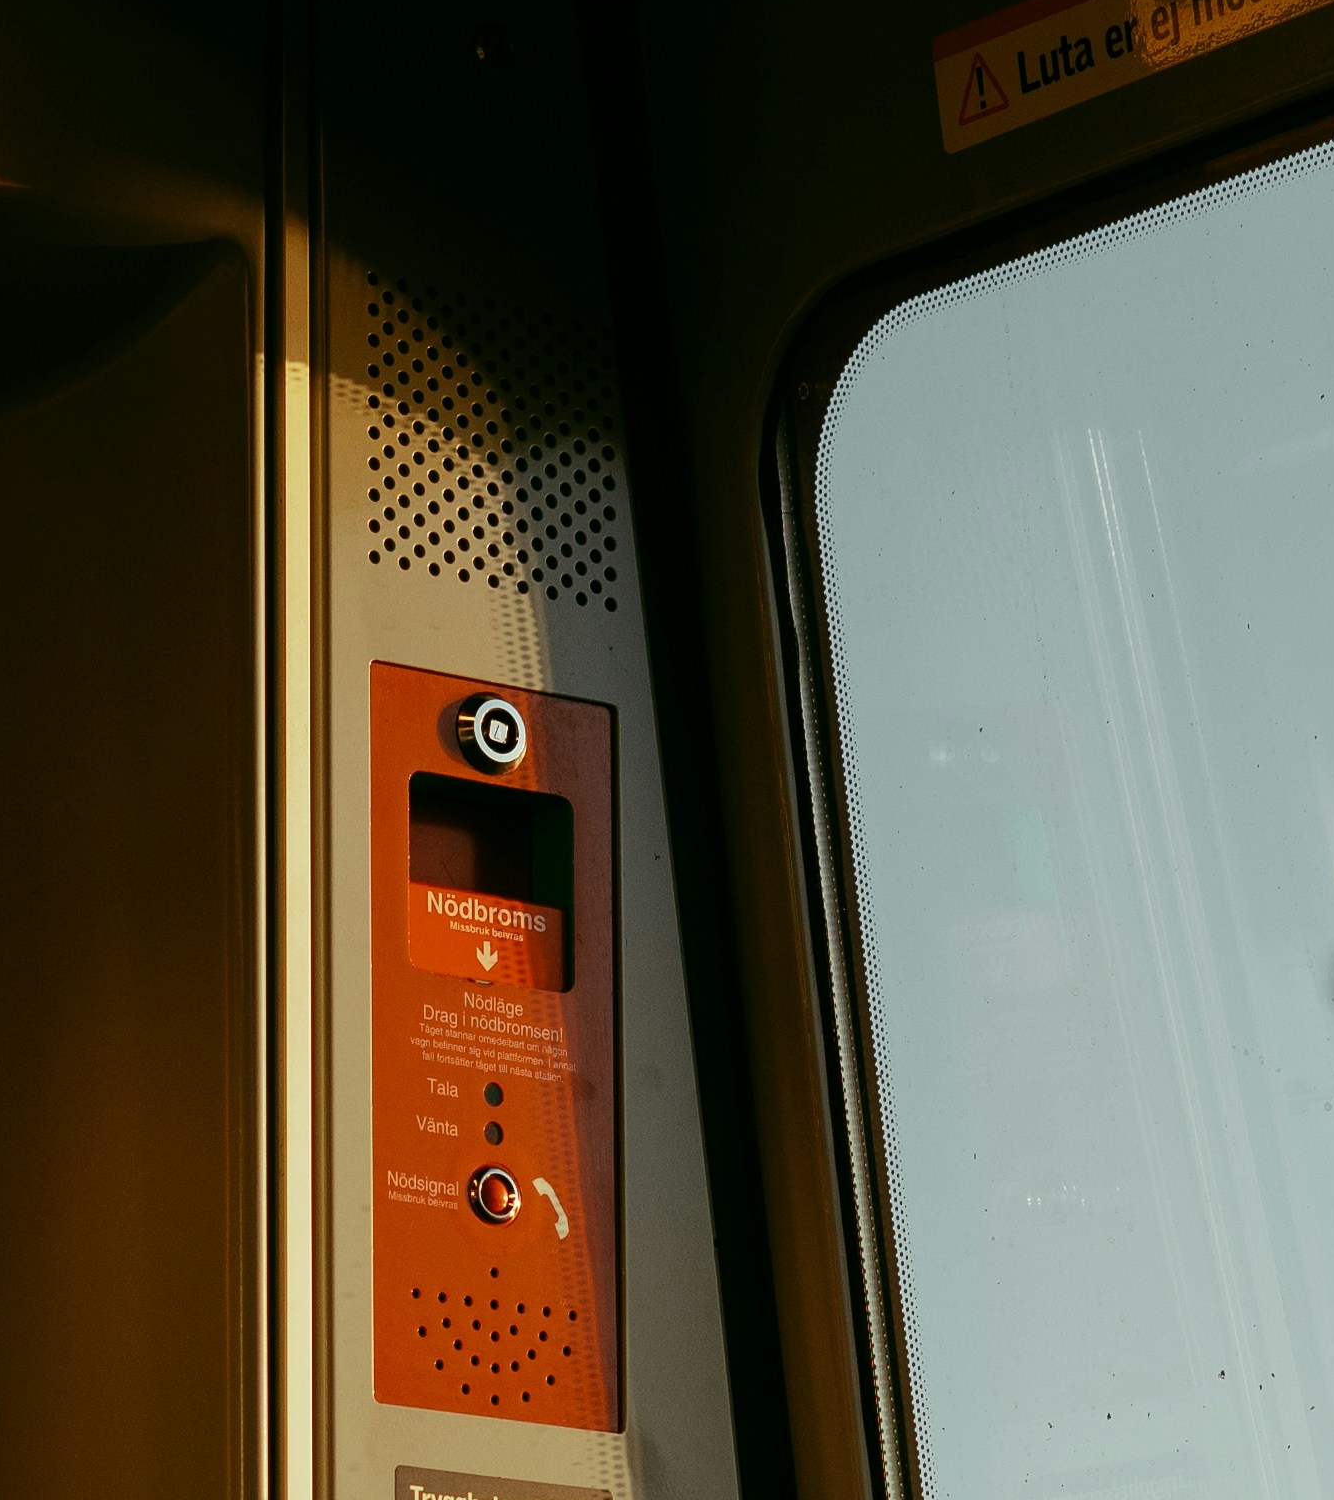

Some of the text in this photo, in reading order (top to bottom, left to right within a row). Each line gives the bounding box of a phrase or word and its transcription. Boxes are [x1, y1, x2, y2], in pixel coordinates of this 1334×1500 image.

[1016, 34, 1096, 95] Luta
[1104, 16, 1139, 60] er
[426, 889, 547, 933] Nödbroms
[463, 990, 524, 1019] Nödläge
[422, 1003, 459, 1029] Drag
[470, 1014, 564, 1044] nödbromsen!
[425, 1076, 460, 1099] Tala
[415, 1114, 459, 1138] Vänta
[386, 1169, 460, 1198] Nödsignal
